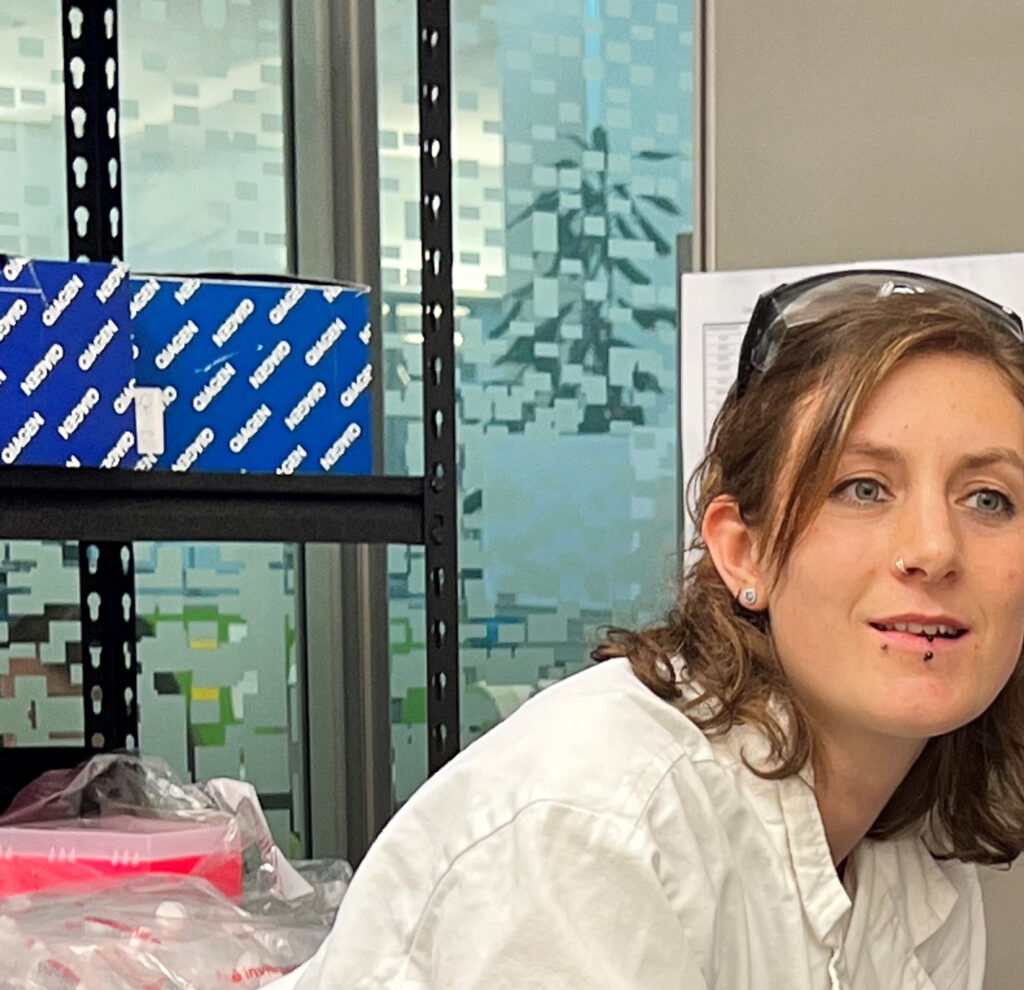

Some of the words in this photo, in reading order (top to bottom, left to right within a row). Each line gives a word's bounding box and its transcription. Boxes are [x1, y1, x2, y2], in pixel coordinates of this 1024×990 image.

[42, 274, 84, 326] QIAGEN
[212, 298, 255, 348] QIAGEN
[78, 319, 119, 370] QIAGEN
[155, 320, 199, 369] QIAGEN
[248, 340, 291, 390] QIAGEN
[305, 317, 347, 367] QIAGEN
[20, 343, 63, 397] QIAGEN
[193, 362, 236, 412] QIAGEN
[58, 387, 100, 440] QIAGEN
[229, 403, 272, 453] QIAGEN
[284, 381, 327, 431] QIAGEN
[1, 411, 45, 465] QIAGEN
[320, 422, 361, 471] QIAGEN
